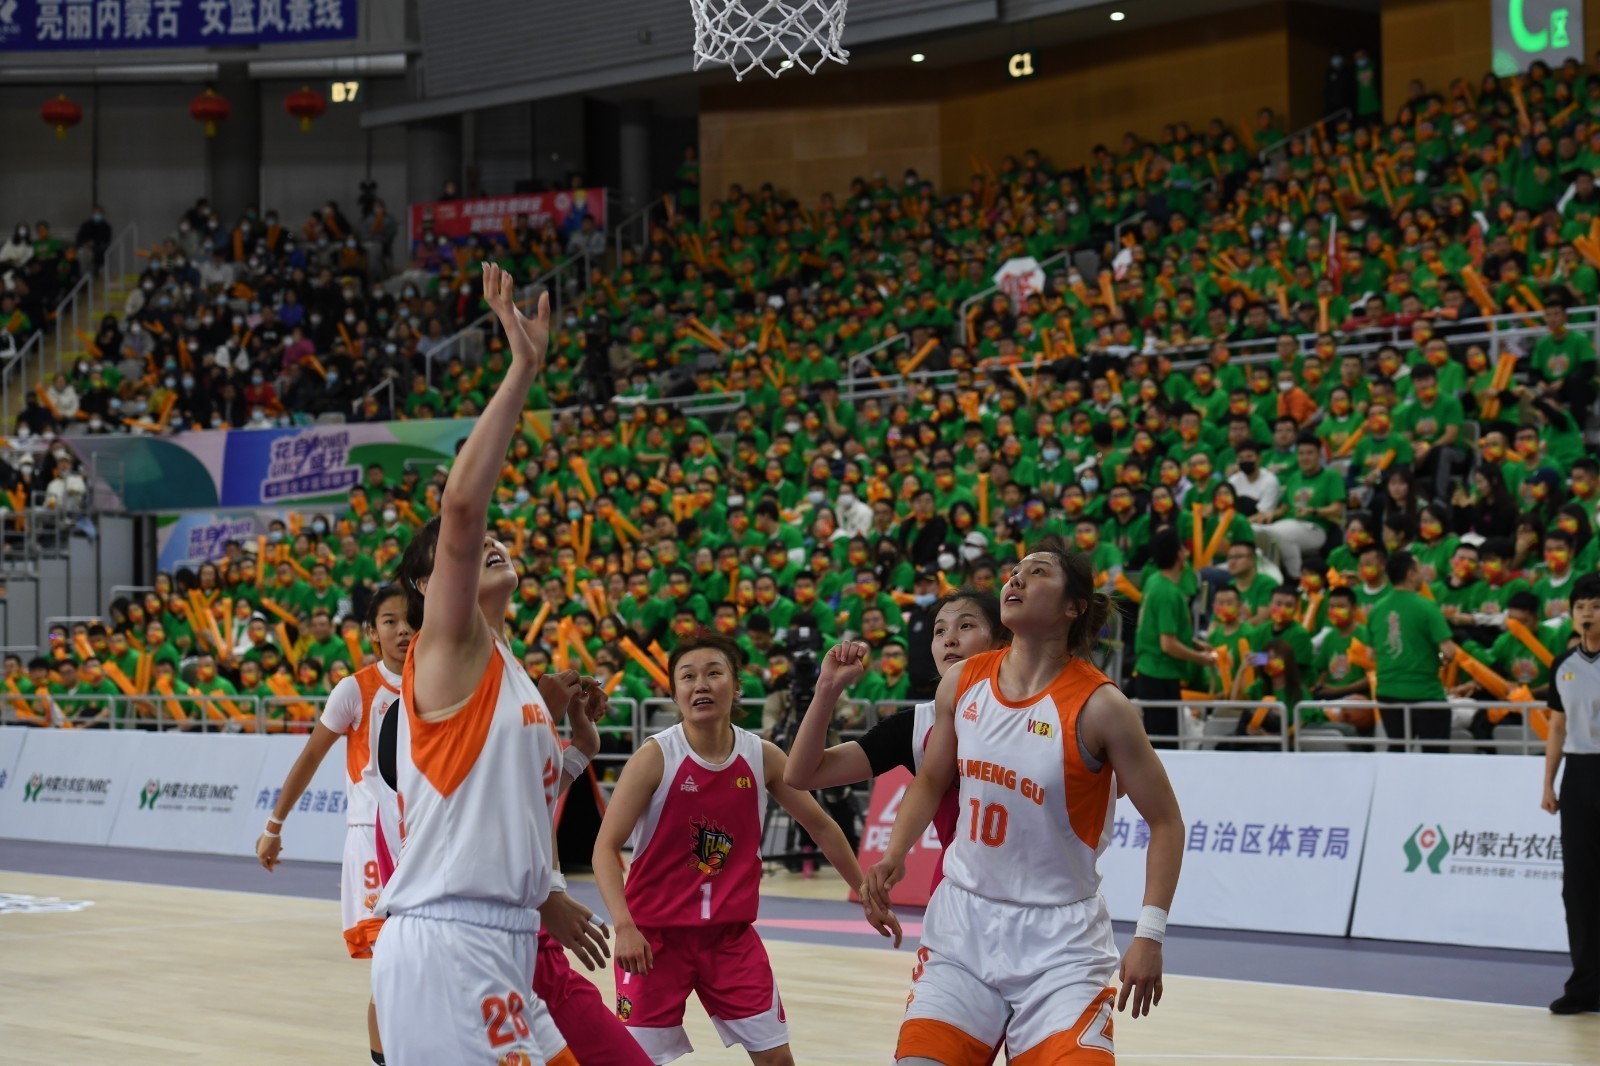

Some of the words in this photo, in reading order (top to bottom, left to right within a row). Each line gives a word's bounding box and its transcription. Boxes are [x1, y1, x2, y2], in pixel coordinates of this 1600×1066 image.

[36, 0, 182, 40] 亮丽内蒙古
[200, 0, 344, 36] 女篮风景线
[1008, 52, 1033, 77] C1
[331, 81, 359, 103] B7
[967, 760, 1017, 790] MENG
[1020, 777, 1045, 806] GU
[968, 797, 1009, 848] 10
[1109, 816, 1352, 860] 内蒙自治区体育局
[364, 860, 381, 890] 9
[699, 882, 712, 920] 1
[480, 991, 530, 1049] 28
